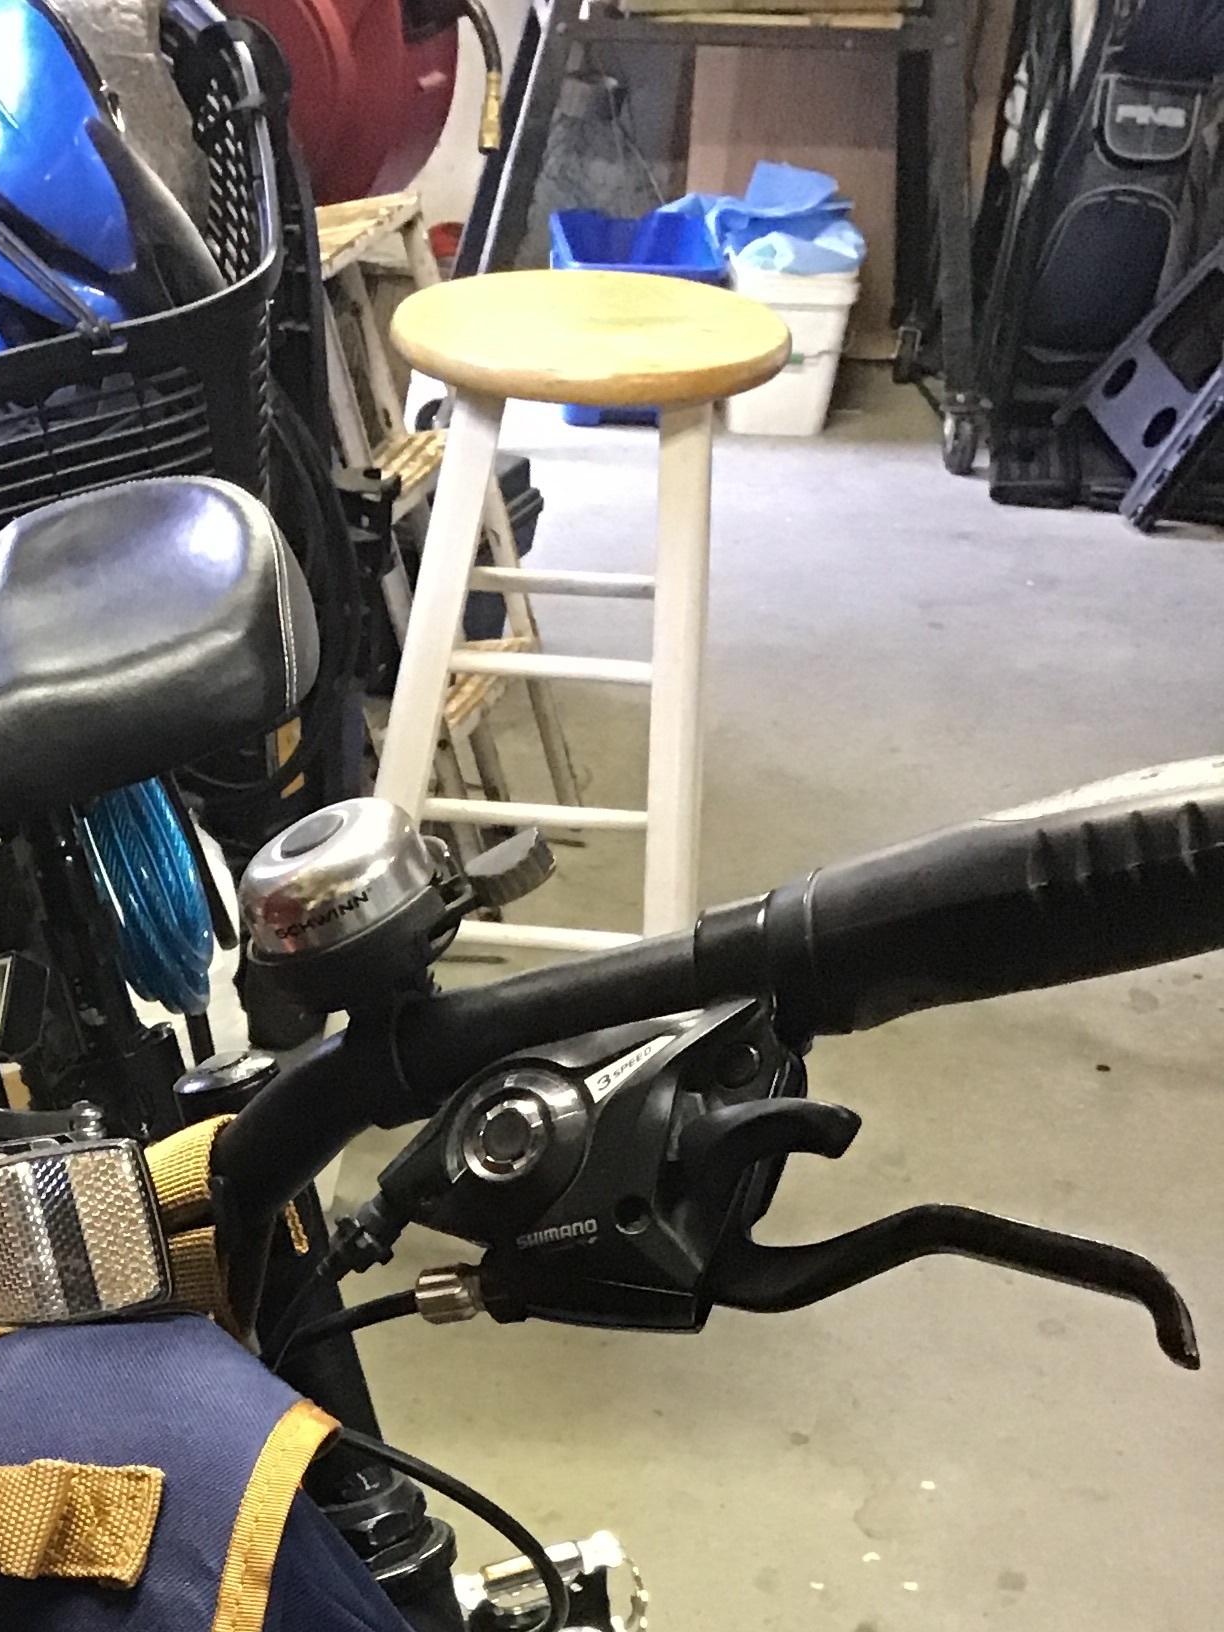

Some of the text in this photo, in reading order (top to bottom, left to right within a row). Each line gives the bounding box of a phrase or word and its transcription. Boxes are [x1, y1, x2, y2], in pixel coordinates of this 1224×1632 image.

[275, 891, 369, 939] SCHWINN
[597, 1045, 652, 1092] 3 SPEED
[516, 1218, 598, 1250] SHIMANO
